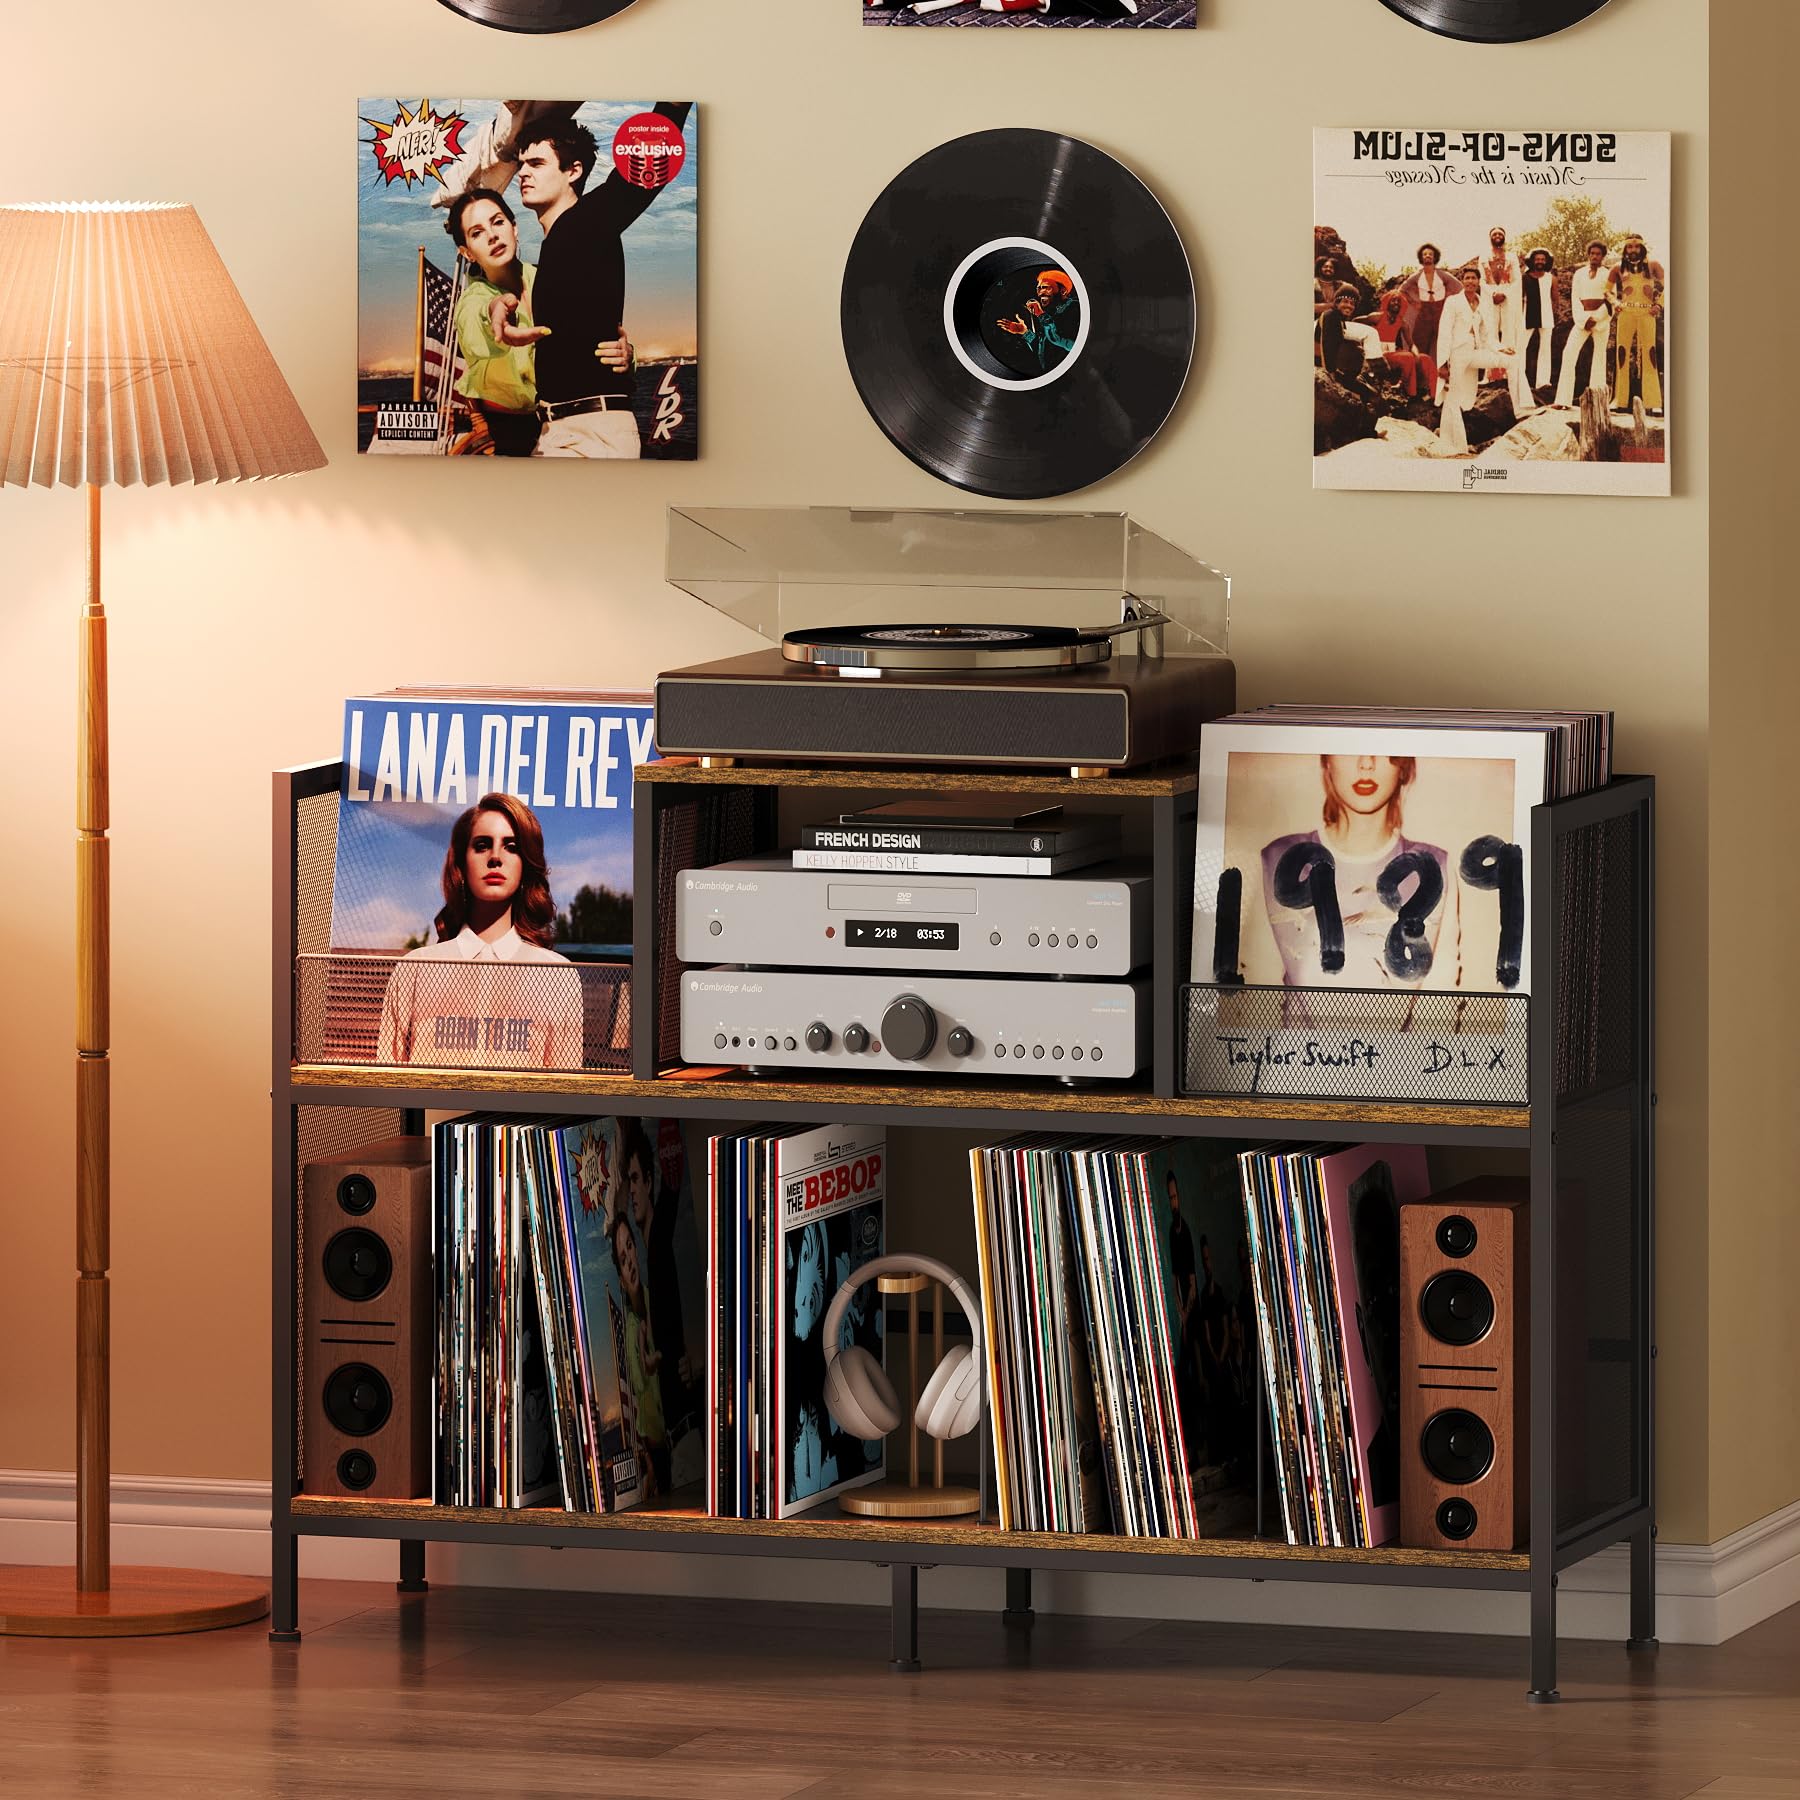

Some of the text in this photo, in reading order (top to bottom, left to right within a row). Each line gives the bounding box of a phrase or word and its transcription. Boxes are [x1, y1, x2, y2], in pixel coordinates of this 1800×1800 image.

[650, 125, 670, 133] inside
[396, 126, 440, 160] NFR!
[615, 141, 683, 156] exclusive
[381, 403, 434, 411] PARENTAL
[380, 413, 435, 428] ADVISORY
[381, 429, 434, 439] EXPLICIT CONTENT
[348, 711, 654, 808] LANA DEL REY
[815, 832, 869, 847] FRENCH
[872, 833, 921, 849] DESIGN
[806, 855, 919, 870] KELLY HOPPEN STYLE
[695, 881, 758, 892] Cambridge Audio
[1213, 834, 1525, 990] 1989
[874, 927, 945, 940] 2/18 03:53
[700, 982, 762, 993] Cambridge Audio
[434, 1015, 533, 1052] BORN TO DIE
[1216, 1035, 1296, 1092] Taylor
[1303, 1039, 1379, 1068] Swift
[786, 1181, 804, 1198] MEET
[804, 1154, 882, 1211] BEBOP
[786, 1195, 803, 1216] THE
